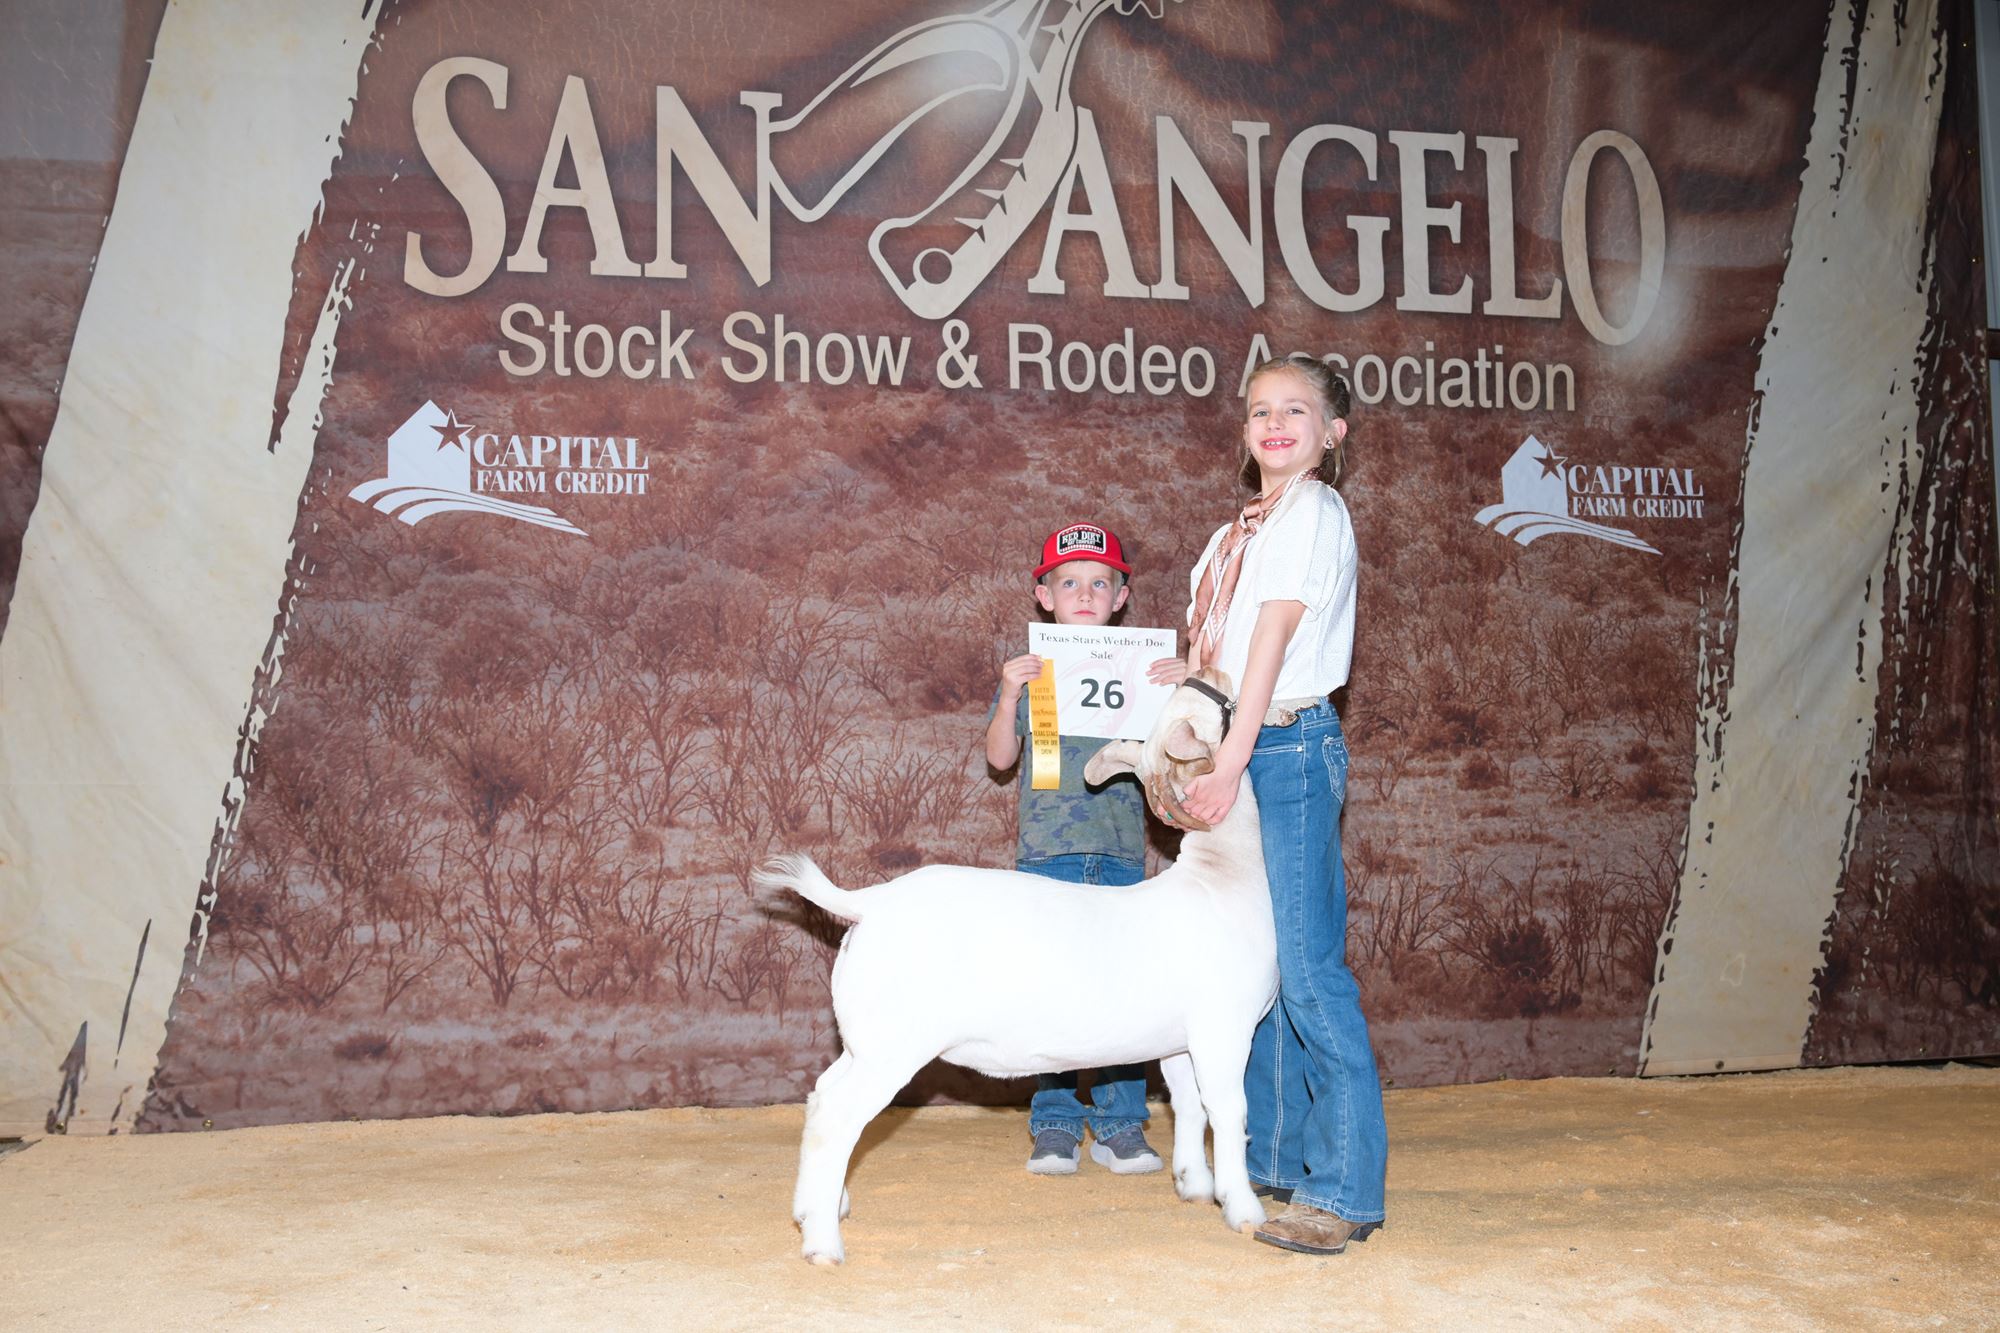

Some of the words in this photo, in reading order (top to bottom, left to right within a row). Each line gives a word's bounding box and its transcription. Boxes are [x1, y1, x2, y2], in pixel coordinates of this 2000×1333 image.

[404, 57, 781, 297] SAN
[1027, 105, 1666, 346] ANGELO
[498, 303, 696, 381] Stock
[720, 311, 911, 386] Show
[936, 319, 983, 390] &
[1008, 322, 1216, 397] Rodeo
[1237, 333, 1576, 411] Aociation
[473, 433, 649, 470] CAPITAL
[476, 469, 546, 493] FARM
[555, 471, 650, 495] CREDIT
[1568, 464, 1704, 497] CAPITAL
[1572, 496, 1626, 517] FARM
[1632, 497, 1705, 519] CREDIT
[1062, 531, 1079, 545] RED
[1081, 530, 1101, 544] DIRT
[1039, 632, 1070, 643] Texas
[1072, 635, 1100, 645] Stars
[1103, 636, 1142, 647] Wether
[1145, 638, 1166, 648] Doe
[1090, 651, 1113, 661] Sale
[1080, 678, 1125, 710] 26
